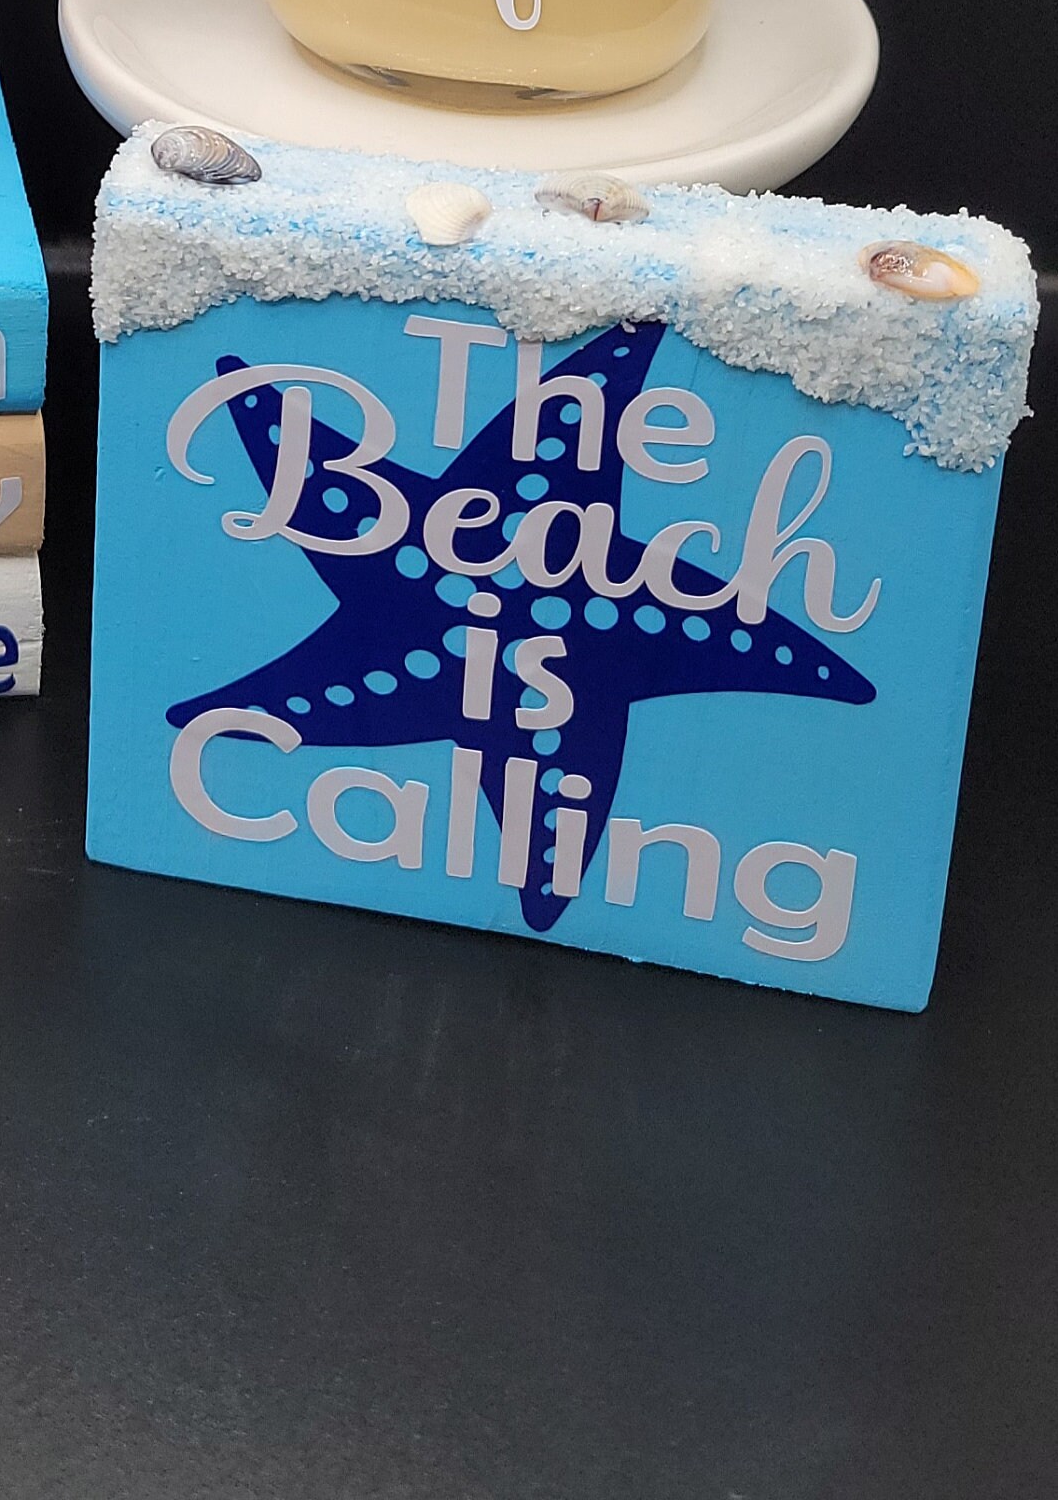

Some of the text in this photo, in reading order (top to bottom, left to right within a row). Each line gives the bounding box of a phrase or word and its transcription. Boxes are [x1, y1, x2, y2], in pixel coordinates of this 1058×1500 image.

[166, 363, 881, 633] Beach
[404, 314, 715, 483] The
[462, 592, 574, 731] is
[169, 707, 858, 961] Calling
